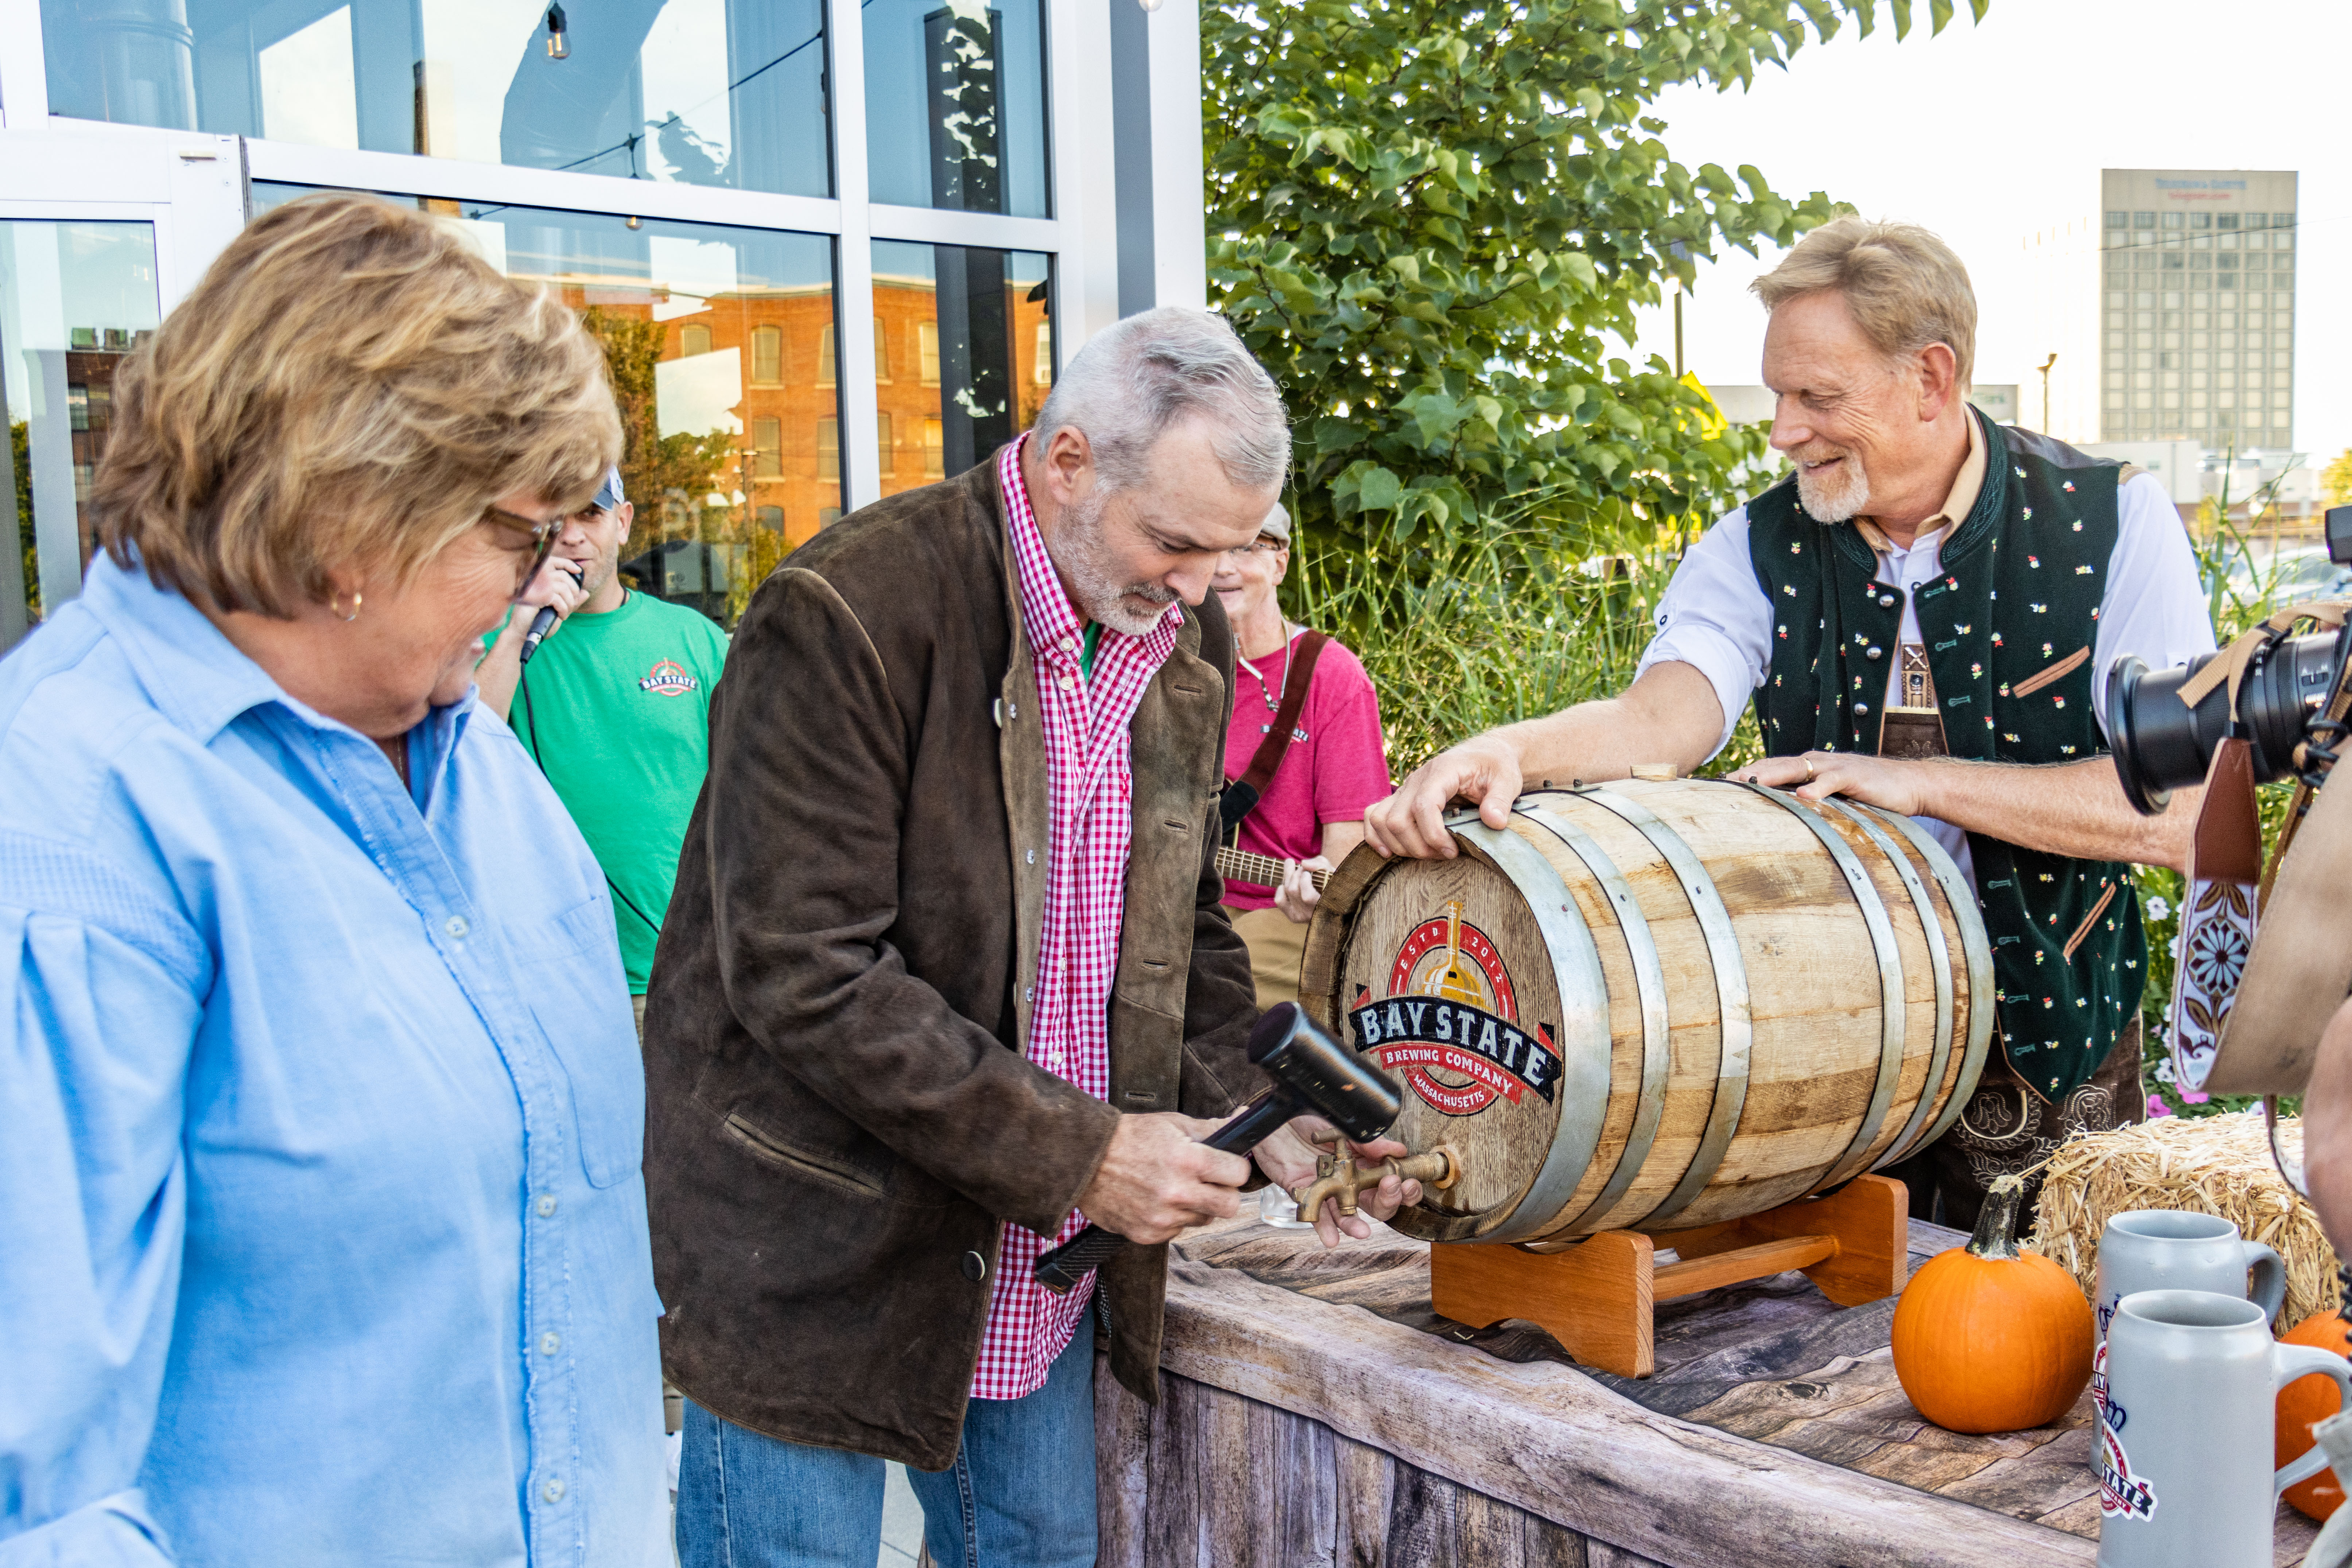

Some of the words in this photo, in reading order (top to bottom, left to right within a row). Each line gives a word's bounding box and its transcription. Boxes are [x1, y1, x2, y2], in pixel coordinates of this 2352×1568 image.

[642, 677, 663, 689] BAY
[665, 675, 696, 688] STATE
[1400, 927, 1438, 970] ESTD
[1471, 937, 1502, 983] 2012
[1360, 1002, 1427, 1045] BAY
[1436, 1005, 1546, 1086] STATE
[1386, 1049, 1439, 1064] BREWING
[1446, 1052, 1513, 1095] COMPANY
[1413, 1074, 1485, 1108] MASSACHUSETTS
[2095, 1373, 2104, 1389] AY
